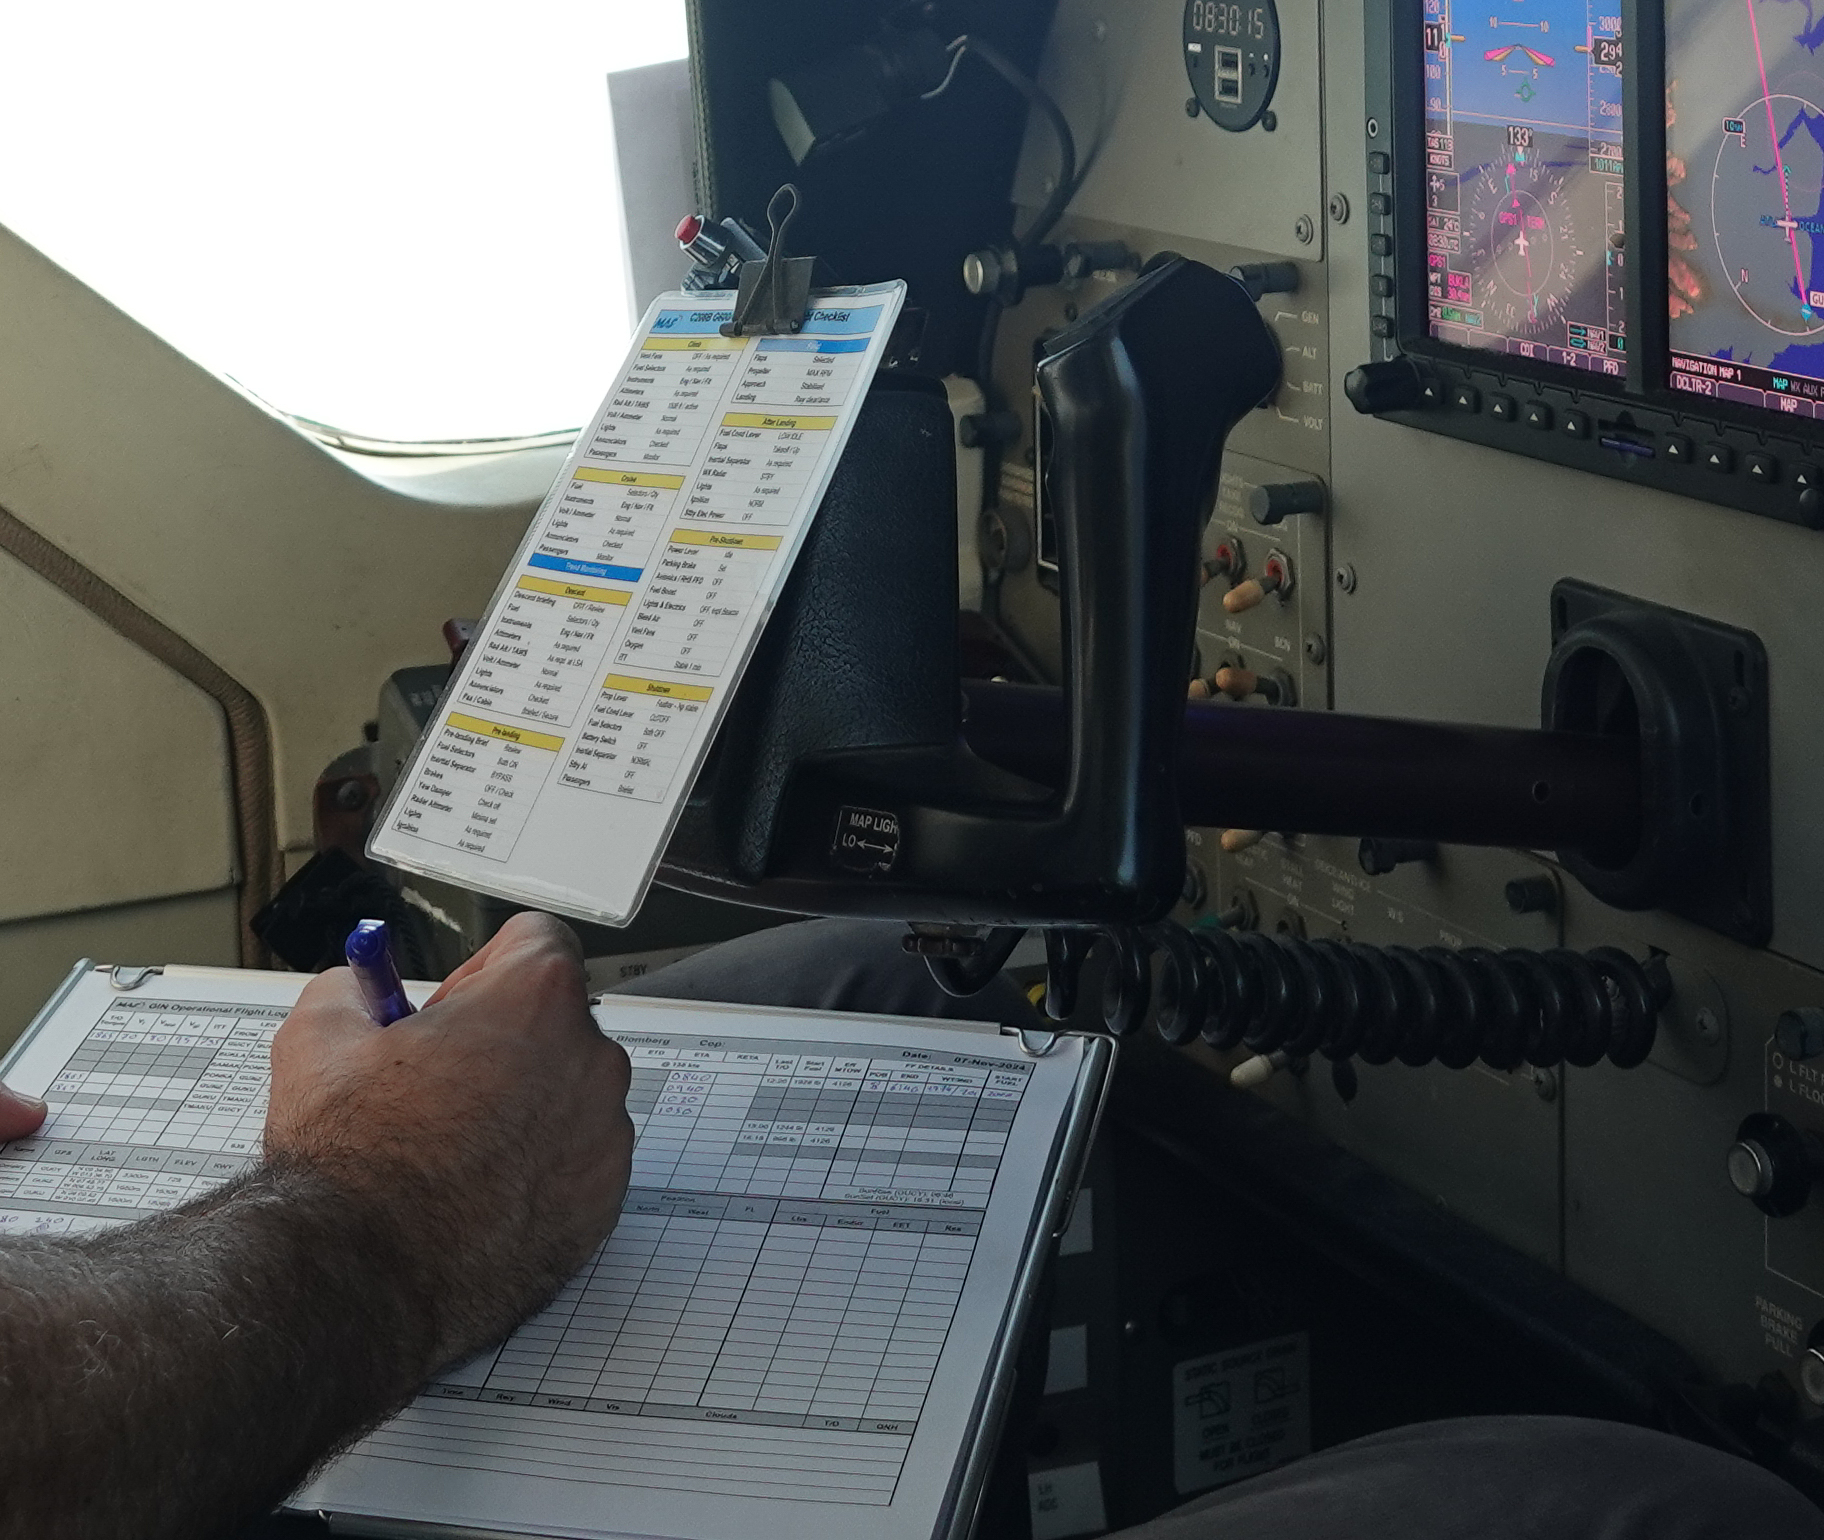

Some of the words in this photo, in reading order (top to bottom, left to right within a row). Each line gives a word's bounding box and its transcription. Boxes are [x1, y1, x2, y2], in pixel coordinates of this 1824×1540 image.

[1561, 351, 1577, 367] 1-2
[1603, 356, 1619, 374] PFD
[1671, 356, 1718, 378] NAVIGATION
[1303, 381, 1324, 395] BATT
[1676, 375, 1712, 396] DCLTR-2
[1772, 377, 1788, 391] MAP
[1802, 383, 1819, 397] AUX
[1780, 396, 1798, 412] MAP
[1303, 415, 1324, 431] VOLT
[849, 812, 873, 829] MAP
[873, 816, 897, 835] LIGH
[842, 832, 857, 848] LO
[171, 1003, 233, 1015] Operational
[233, 1007, 267, 1018] Flight
[1799, 1064, 1819, 1083] FLT
